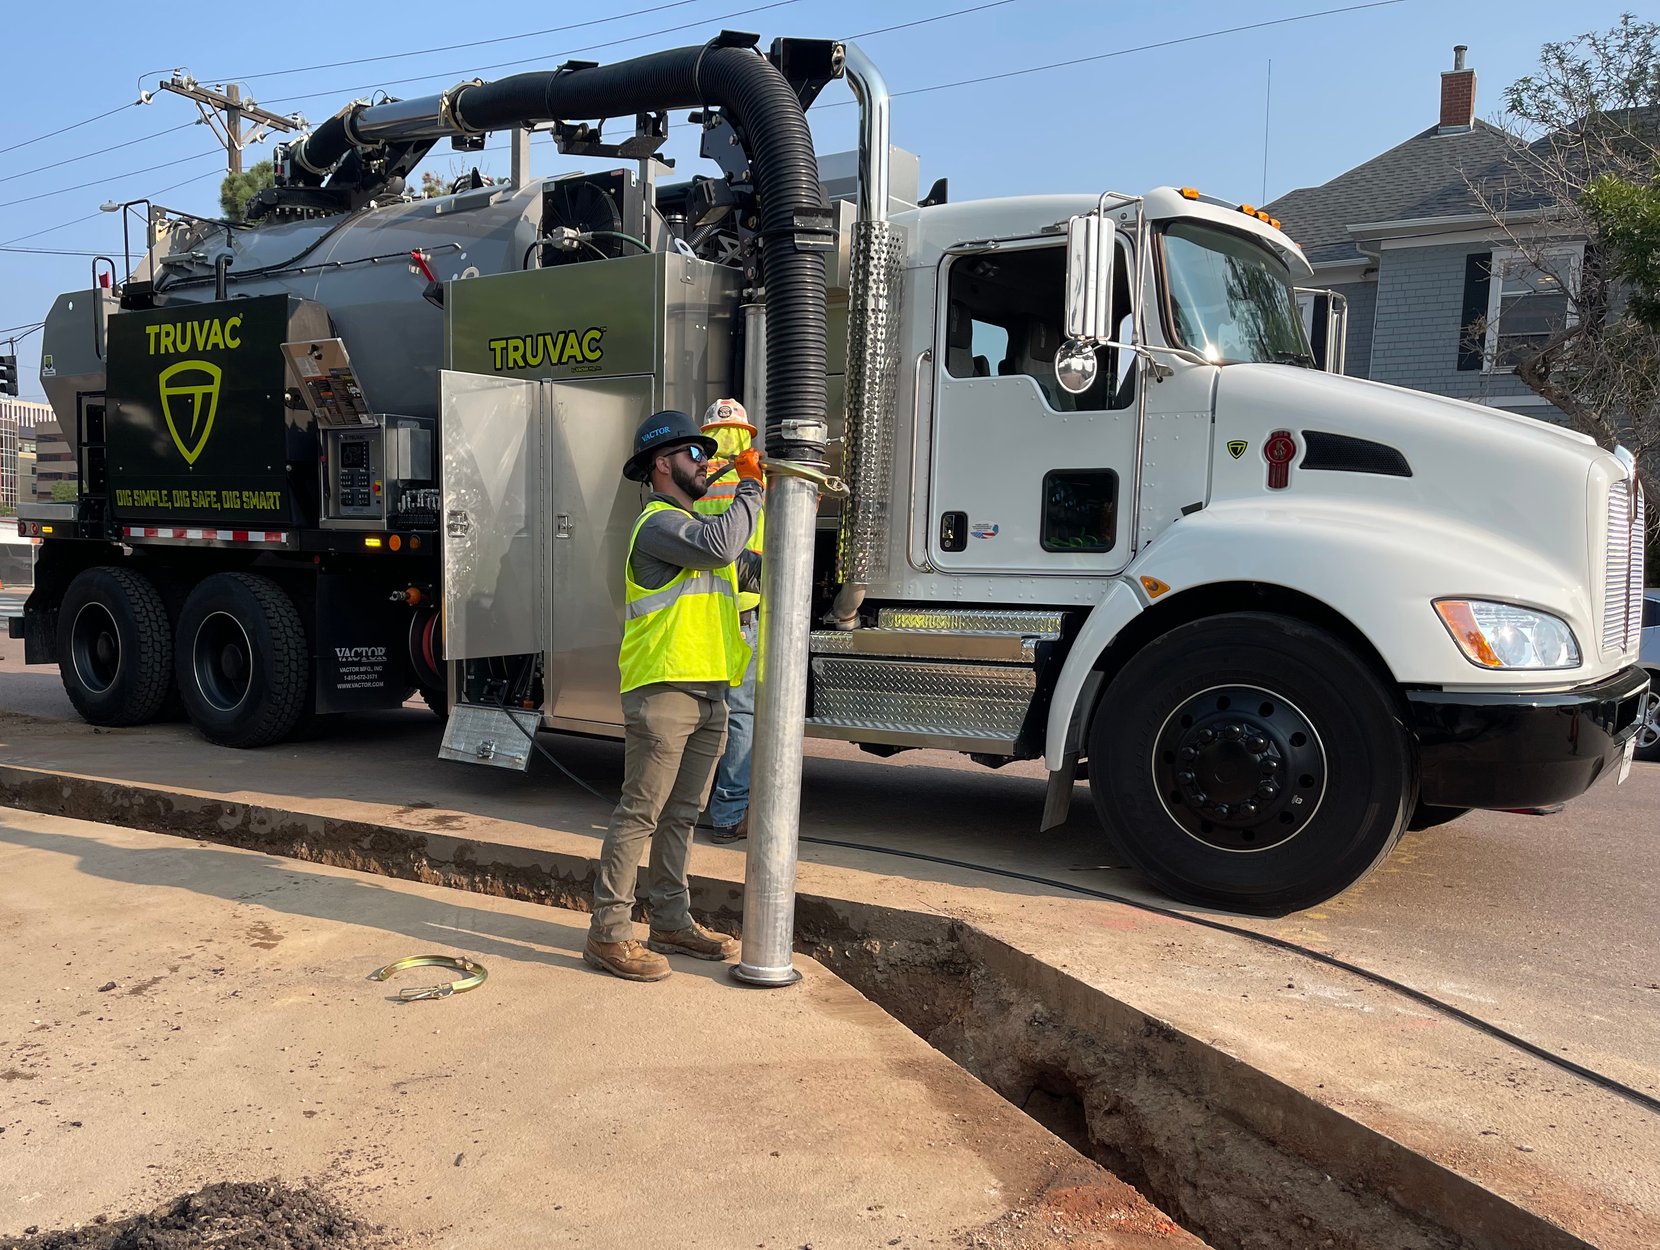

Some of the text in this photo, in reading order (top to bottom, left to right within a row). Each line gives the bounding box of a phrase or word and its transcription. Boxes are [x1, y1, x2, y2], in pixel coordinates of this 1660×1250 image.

[145, 315, 242, 355] TRUVAC
[489, 328, 603, 370] TRUVAC
[641, 426, 671, 443] VACTOR
[115, 489, 281, 511] DIG SIMPLE, DIG SAFE, DIG SMART
[335, 646, 387, 663] VACTOR
